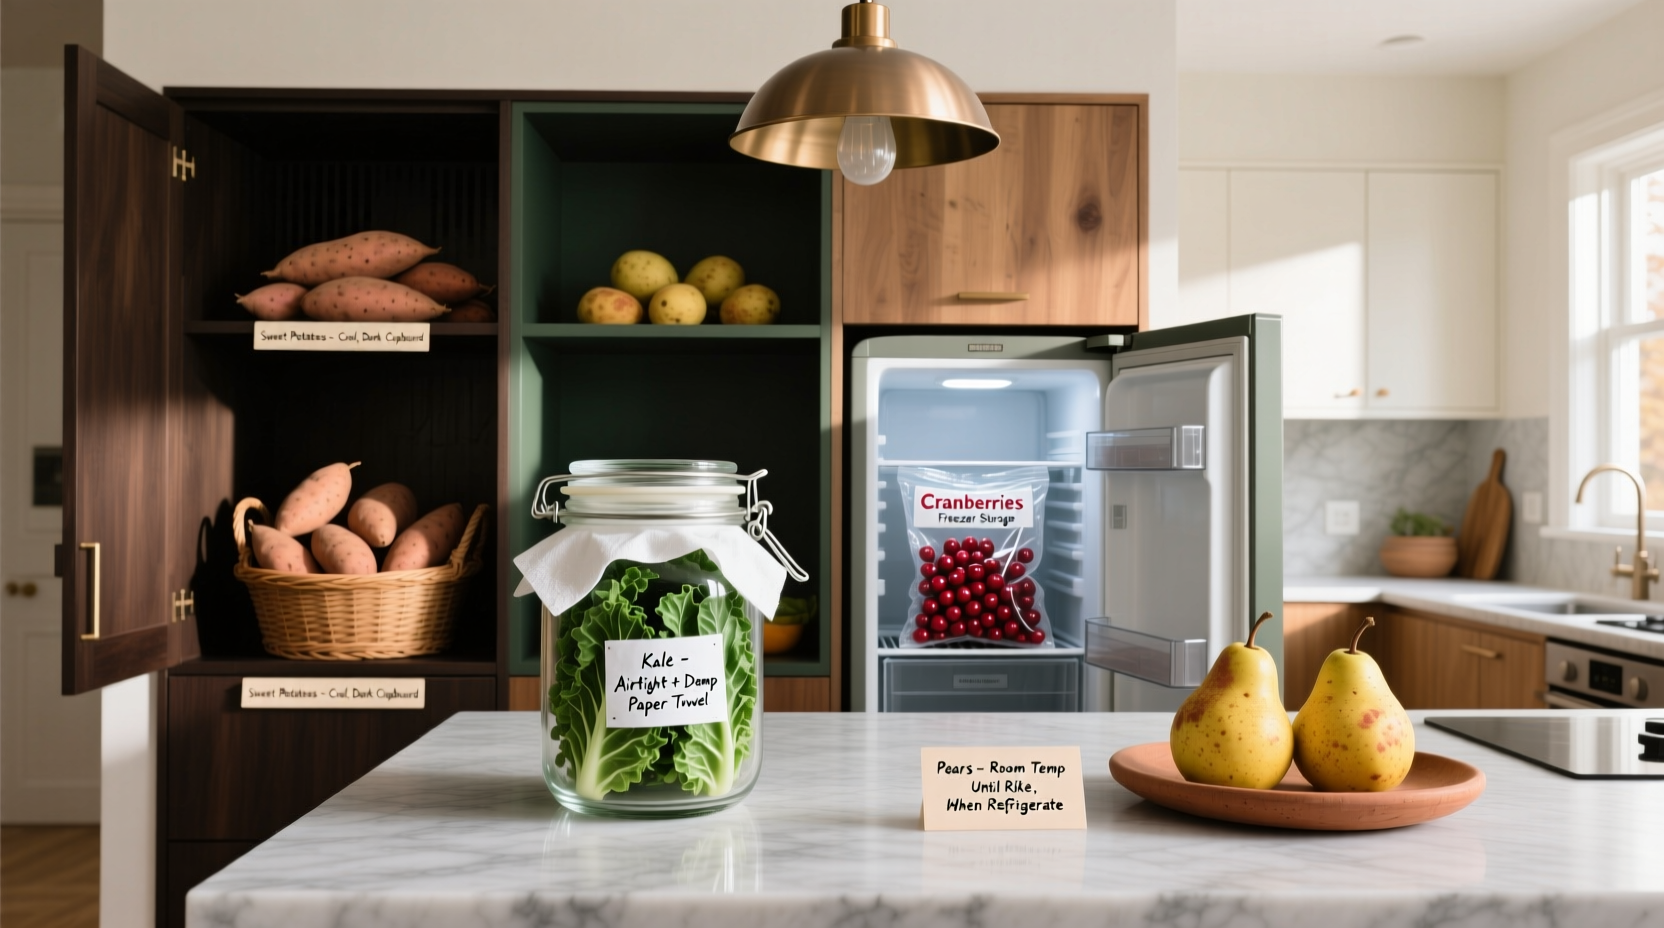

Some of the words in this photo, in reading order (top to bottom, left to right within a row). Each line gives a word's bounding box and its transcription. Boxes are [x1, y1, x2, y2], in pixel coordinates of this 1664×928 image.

[920, 493, 1024, 510] Cranberries
[642, 651, 674, 670] Kale
[614, 675, 667, 695] Airtight
[629, 696, 668, 717] Paper
[937, 760, 973, 775] Pears
[990, 761, 1026, 774] Room
[1031, 761, 1066, 779] Temp
[971, 780, 1000, 793] Until
[946, 798, 982, 812] When
[987, 798, 1064, 816] Refrigerate
